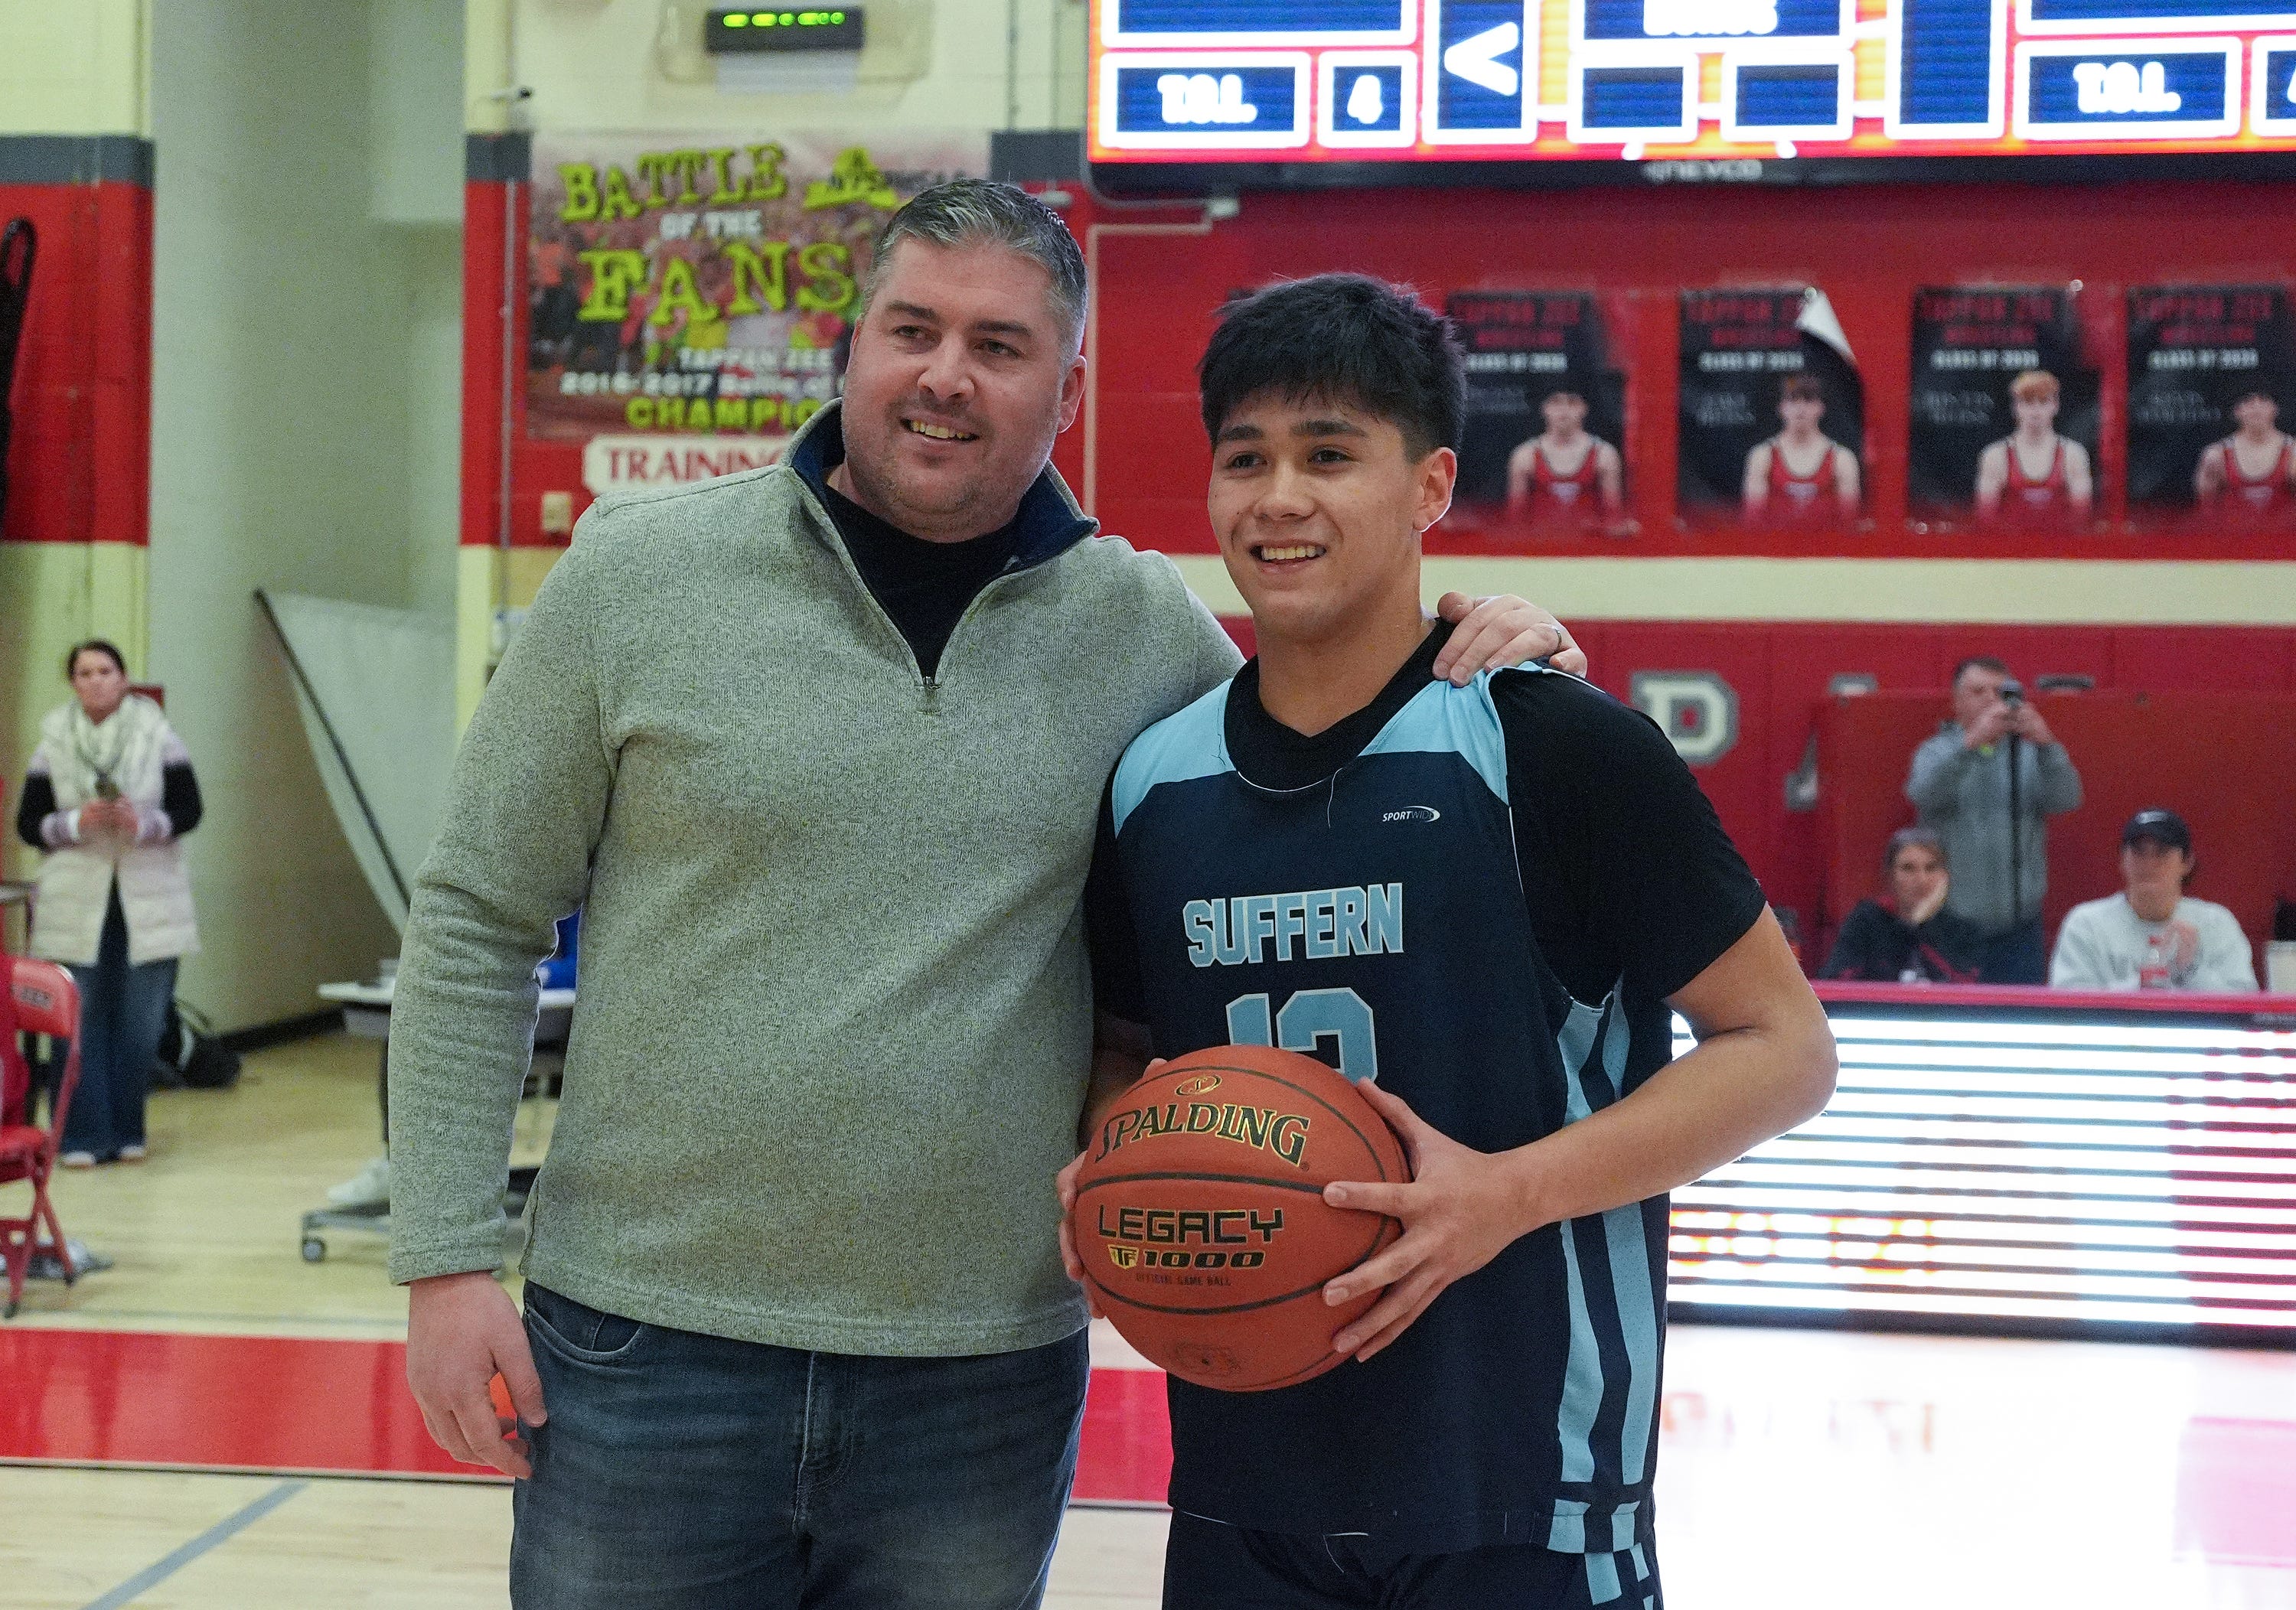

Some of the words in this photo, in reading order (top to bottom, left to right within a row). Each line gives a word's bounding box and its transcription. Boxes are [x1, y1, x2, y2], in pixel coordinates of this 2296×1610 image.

[1346, 74, 1383, 123] 4
[557, 144, 788, 223] BATTLE
[660, 212, 697, 240] OF
[703, 209, 762, 239] THE
[577, 241, 856, 327] FANS
[1182, 882, 1404, 968] SUFFERN
[1095, 1102, 1310, 1167] SPALDING
[1098, 1204, 1284, 1244] LEGACY
[1108, 1245, 1139, 1269] TF
[1144, 1250, 1265, 1269] 1000
[1177, 1274, 1202, 1286] GAME
[1207, 1274, 1231, 1286] BALL
